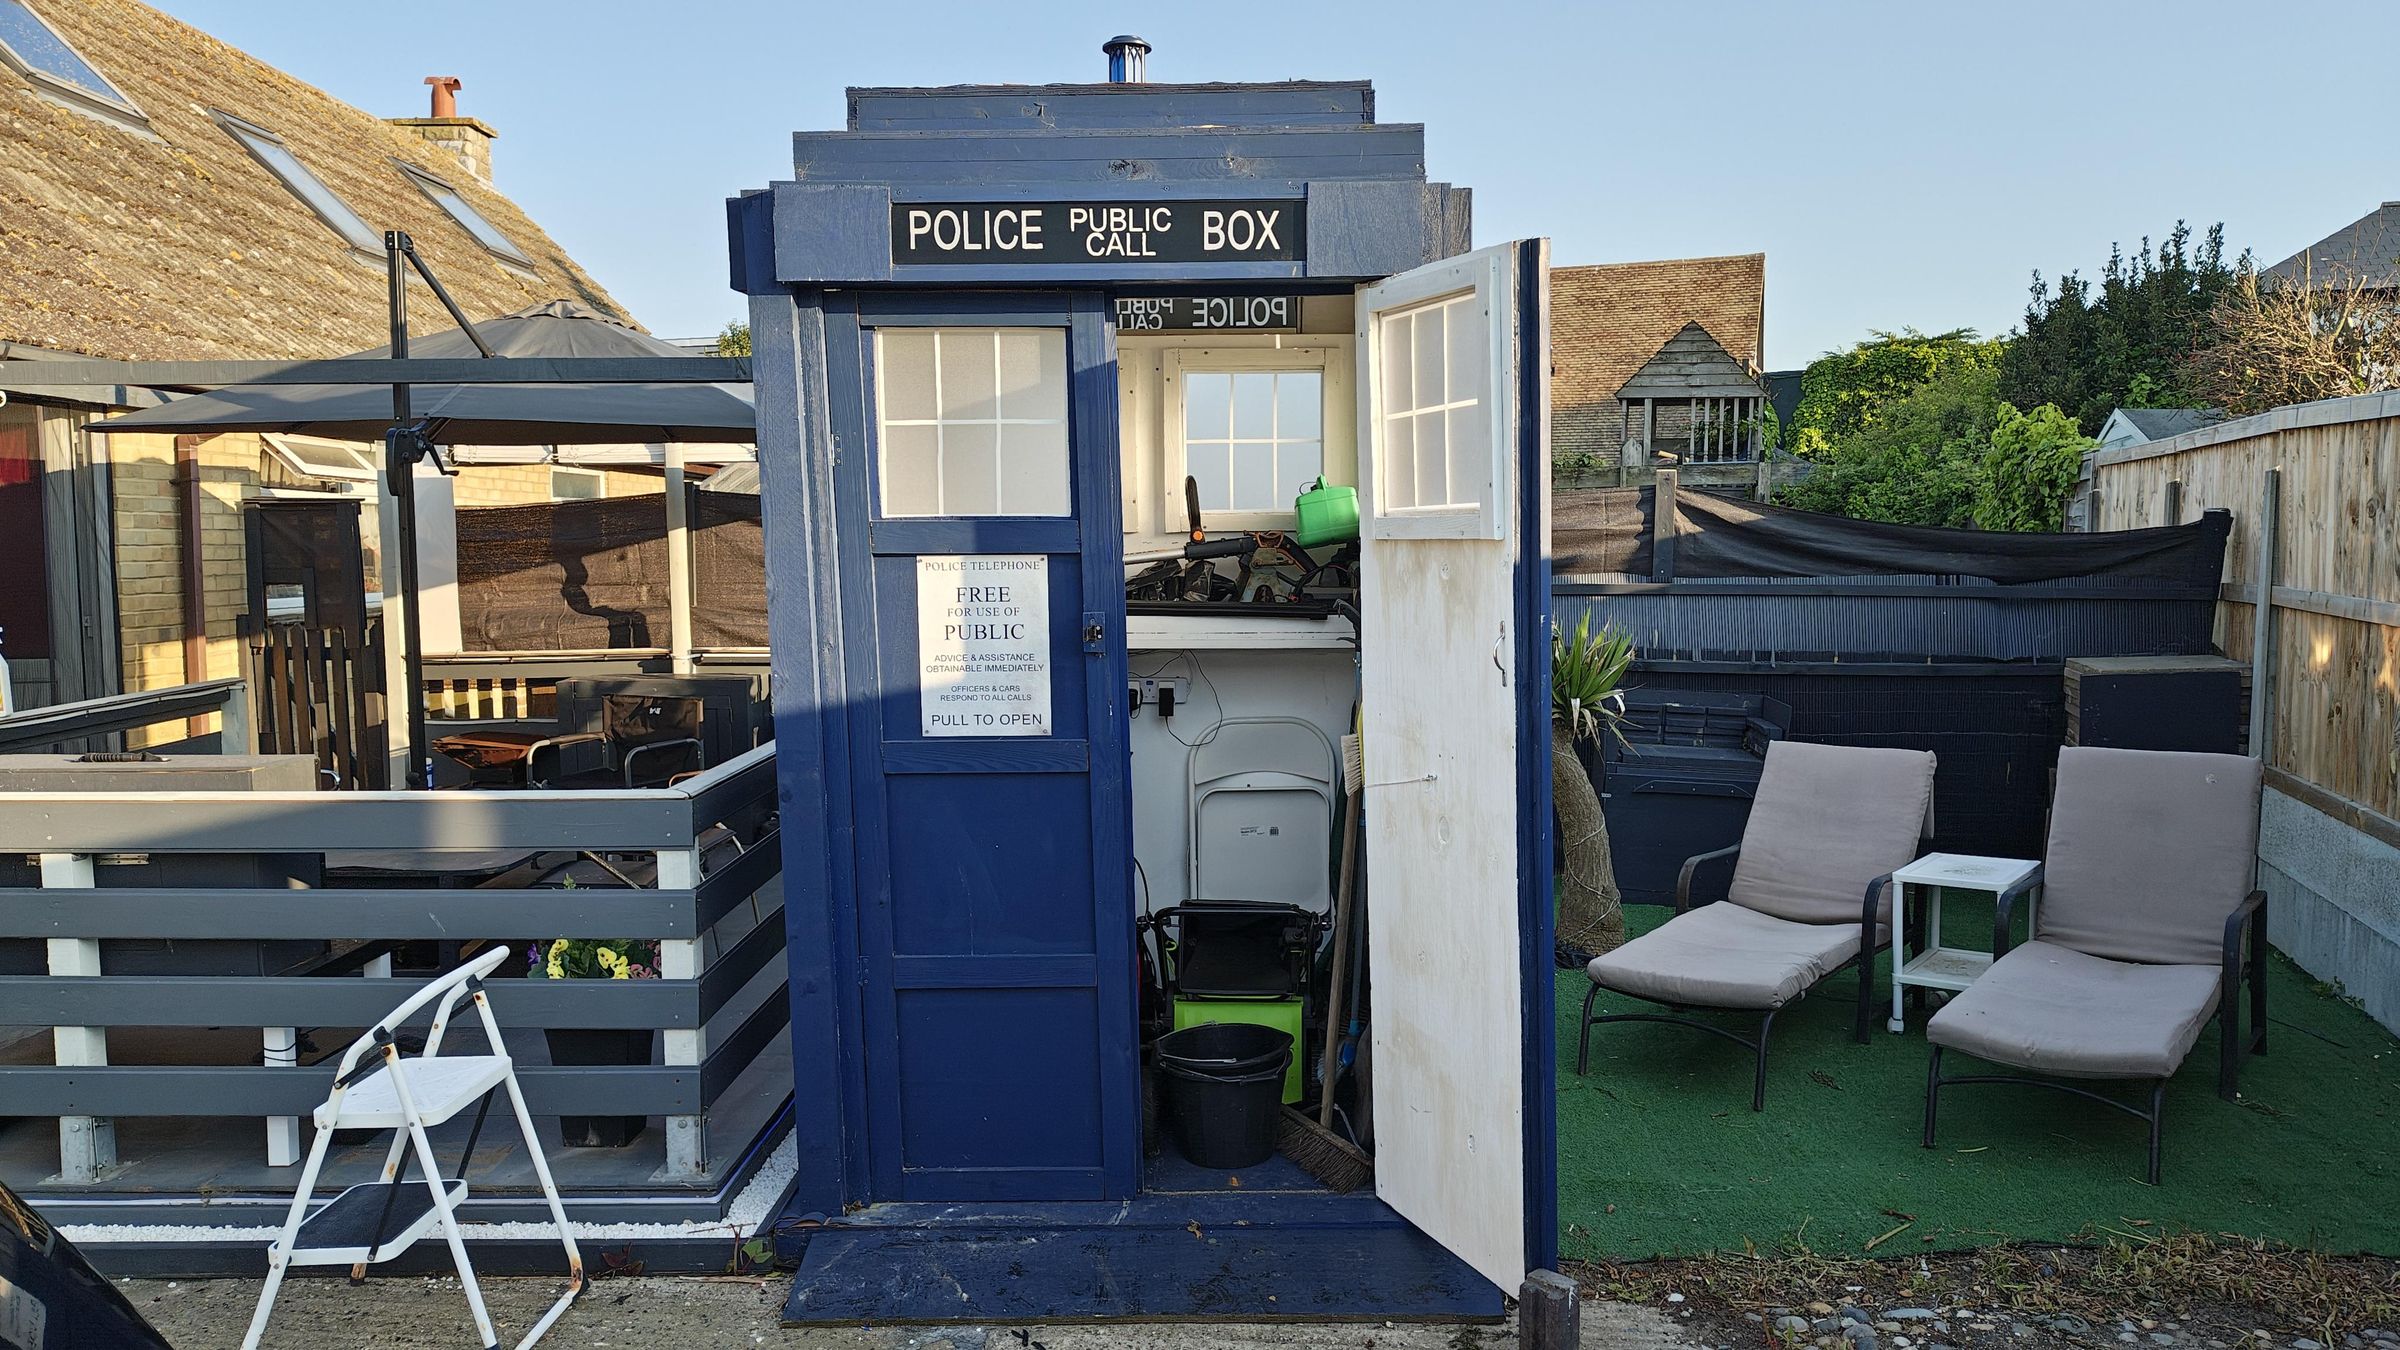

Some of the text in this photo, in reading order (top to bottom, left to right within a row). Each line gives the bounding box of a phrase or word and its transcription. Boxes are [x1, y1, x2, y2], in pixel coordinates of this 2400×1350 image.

[1069, 207, 1172, 233] PUBLIC
[909, 209, 1044, 251] POLICE
[1203, 209, 1280, 252] BOX
[1085, 232, 1157, 257] CALL
[925, 561, 1040, 571] POLICE TELEPHONE
[956, 586, 1011, 603] FREE
[947, 607, 1020, 617] FOR USE OF
[944, 623, 1025, 641] PUBLIC
[934, 653, 1035, 662] ADVICE & ASSISTANCE
[926, 664, 1045, 673] OBTAINABLE IMMEDIATELY
[951, 685, 990, 693] OFFICERS
[940, 694, 978, 702] RESPOND
[931, 713, 1042, 727] PULL TO OPEN
